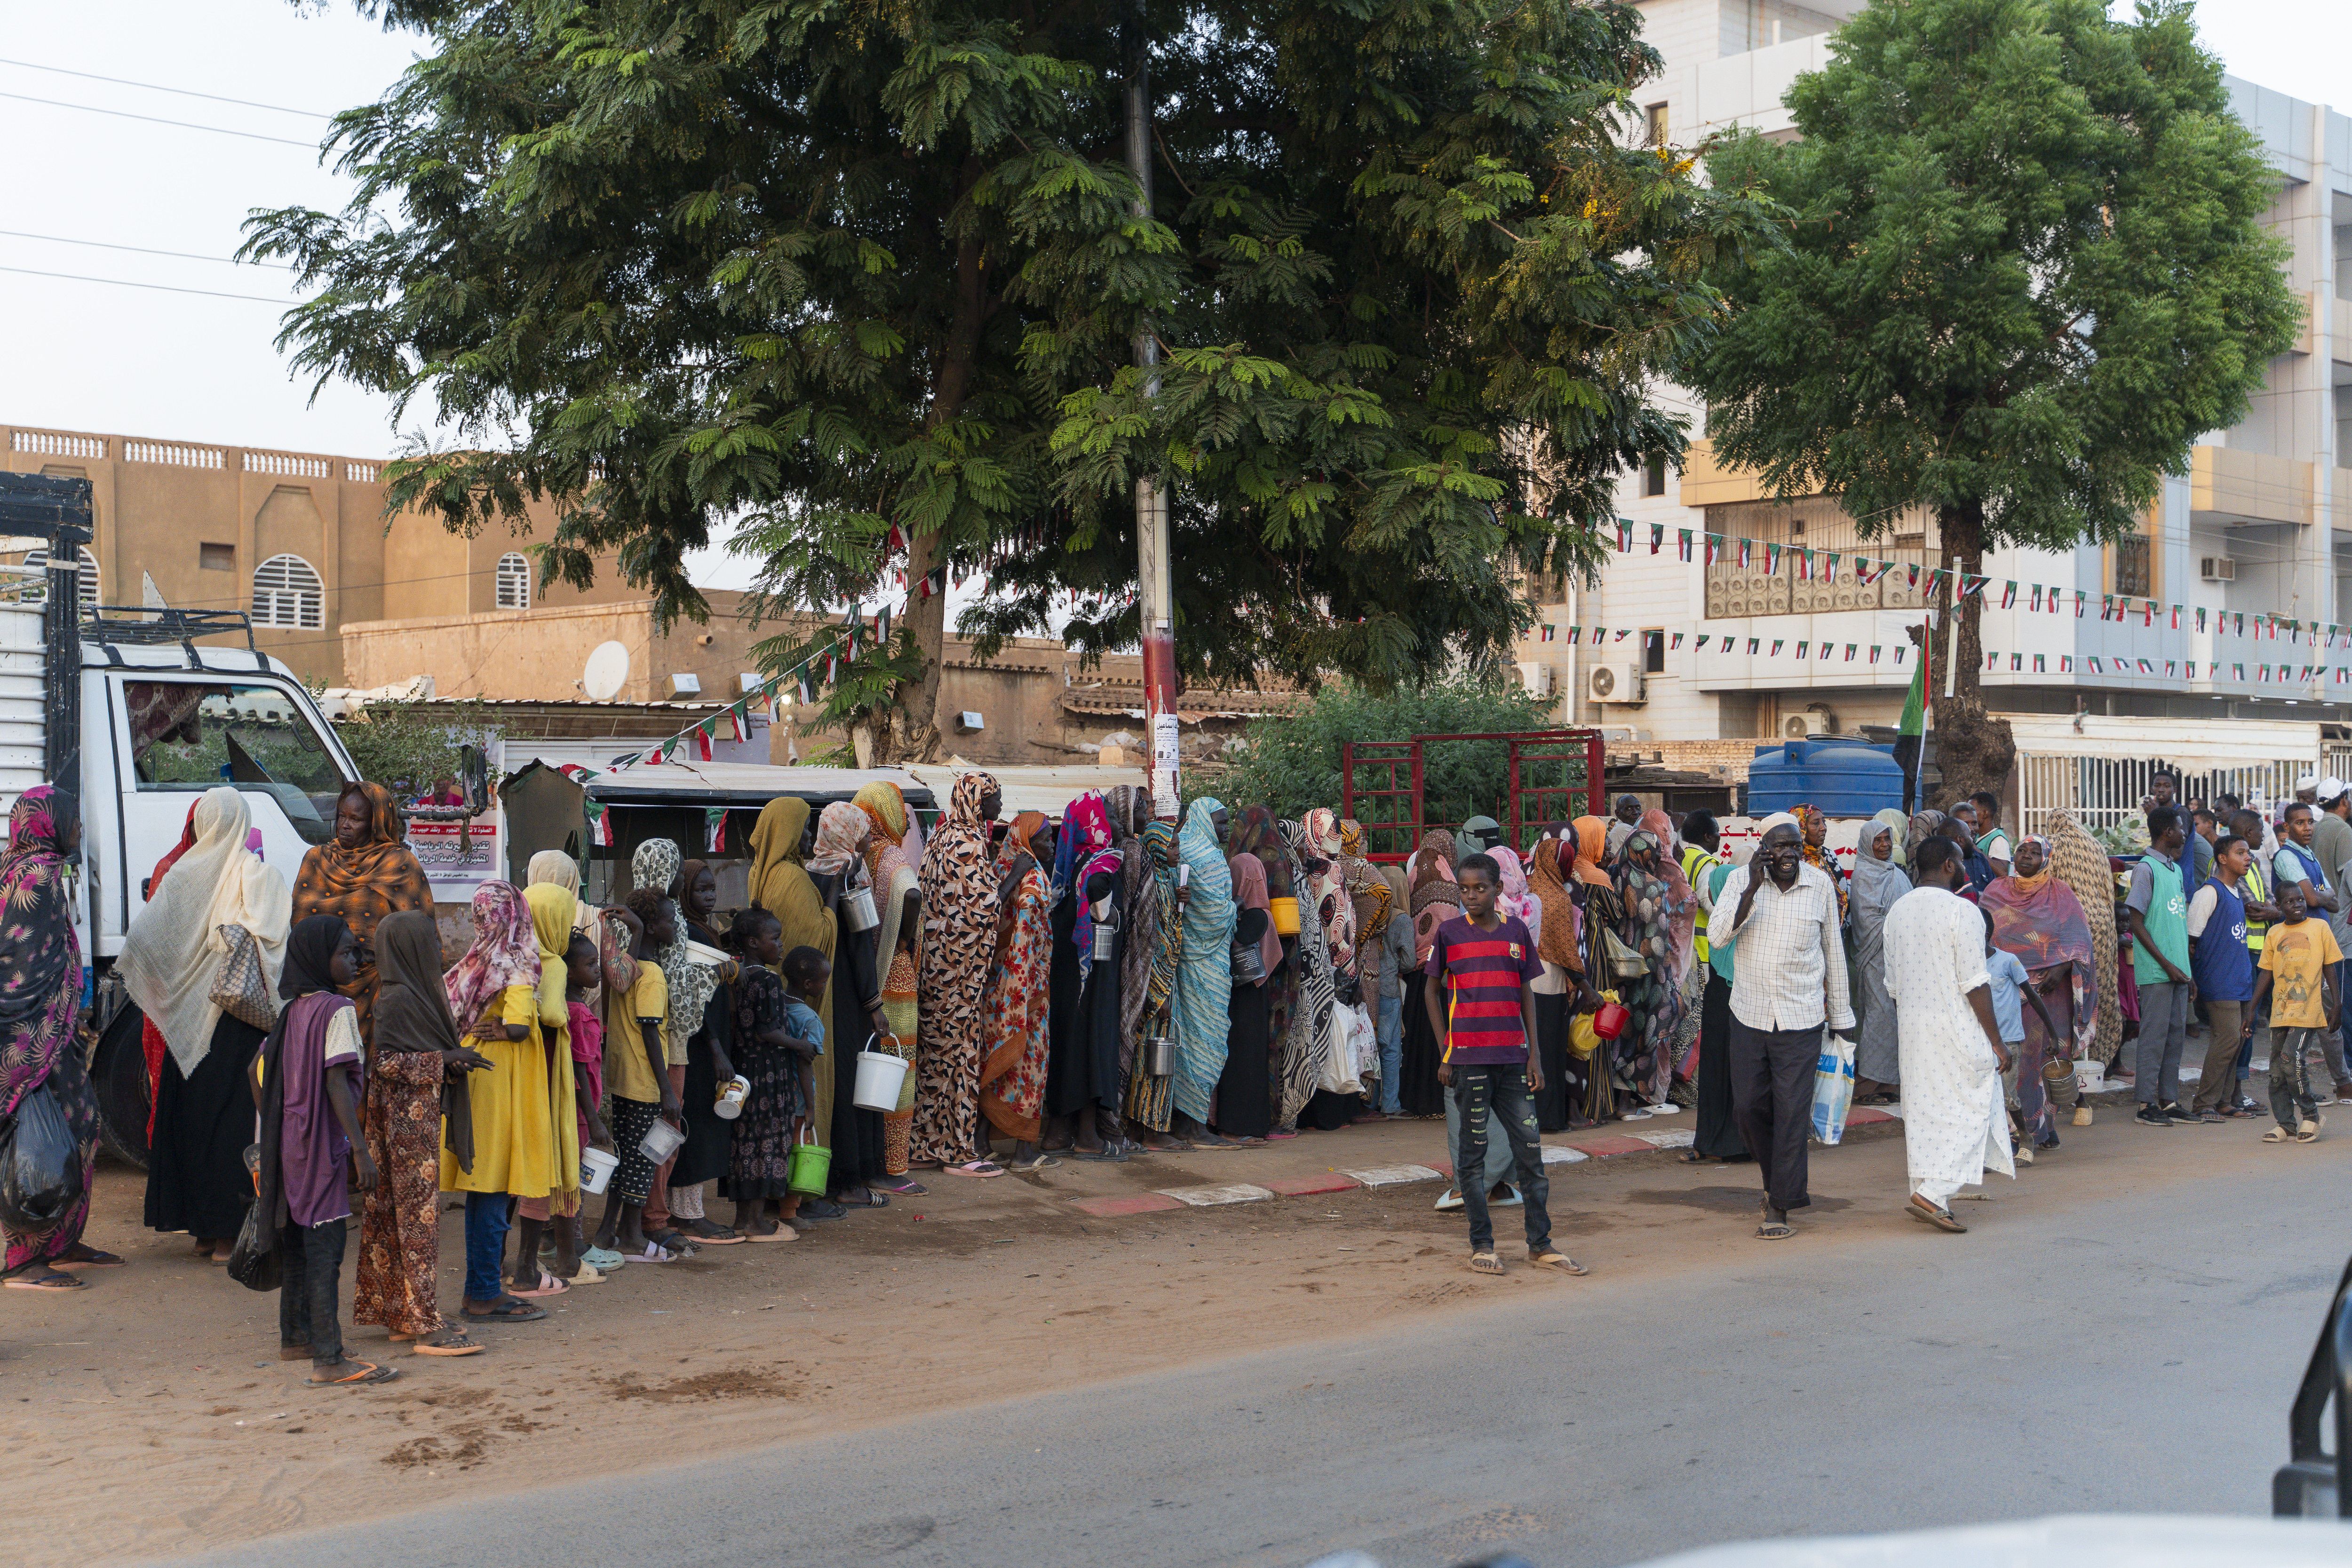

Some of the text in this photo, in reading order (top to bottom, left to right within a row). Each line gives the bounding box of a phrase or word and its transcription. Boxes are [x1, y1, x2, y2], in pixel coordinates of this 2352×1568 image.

[1157, 722, 1174, 730] إسماعيل
[415, 840, 444, 852] الرياضية
[419, 853, 489, 866] المتميزة في خدمة الرياض
